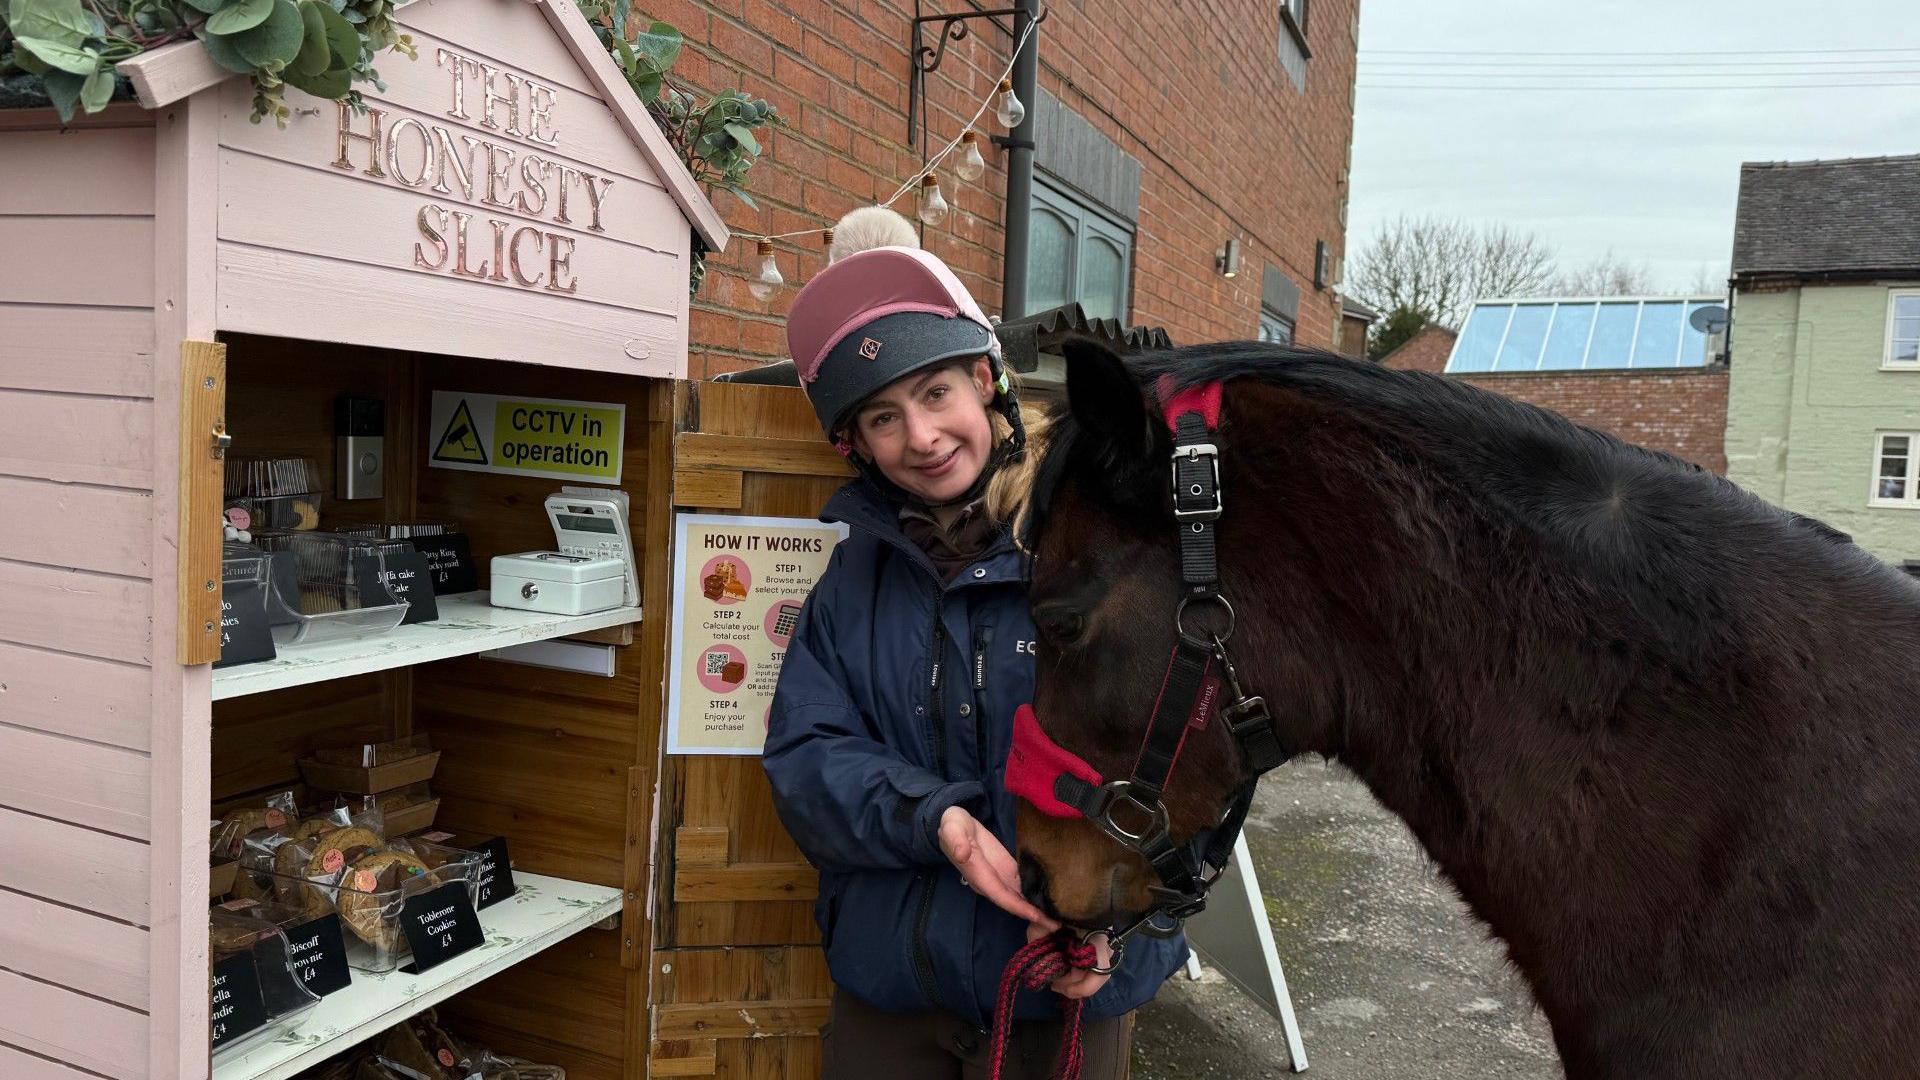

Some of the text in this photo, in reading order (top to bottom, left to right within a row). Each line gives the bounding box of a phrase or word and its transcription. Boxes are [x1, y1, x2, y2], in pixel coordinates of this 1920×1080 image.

[437, 47, 560, 148] THE
[330, 99, 615, 232] HONESTY
[414, 203, 578, 294] SLICE
[512, 408, 602, 437] CCTV in
[502, 441, 609, 468] operation
[704, 534, 822, 553] HOW IT WORKS
[428, 561, 443, 571] ocky
[775, 563, 796, 573] STEP
[398, 568, 416, 580] cake
[765, 576, 812, 585] Browse and
[755, 586, 811, 595] select your tre
[220, 614, 240, 627] kies
[713, 610, 742, 619] STEP 2
[703, 621, 760, 632] Calculate your
[713, 632, 731, 640] total
[771, 652, 786, 661] STE
[710, 700, 738, 709] STEP 4
[1196, 684, 1214, 723] LeMieux
[704, 712, 746, 722] Enjoy your
[704, 723, 745, 732] purchase!
[417, 904, 456, 926] Toblerone
[427, 919, 457, 936] Cookies
[442, 932, 453, 948] £4
[212, 974, 227, 988] der
[303, 966, 316, 982] £4
[213, 989, 231, 1004] ella
[212, 1004, 234, 1021] ndie
